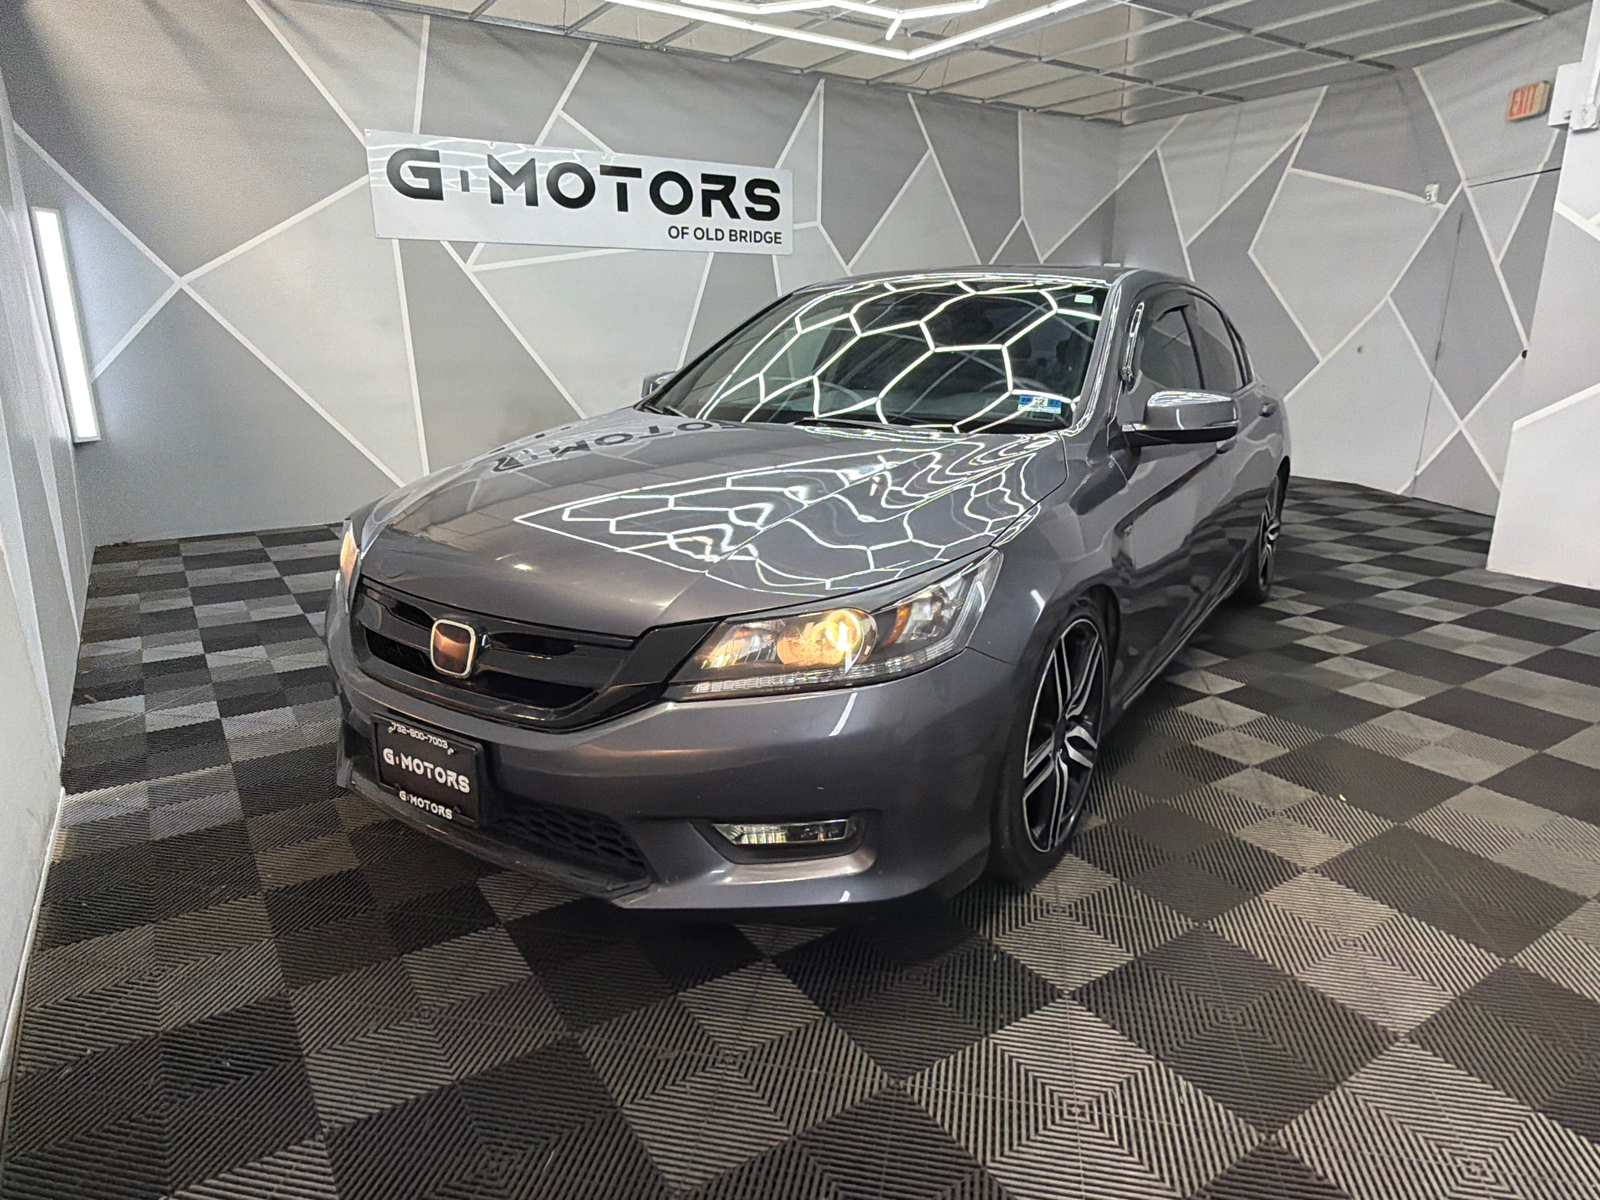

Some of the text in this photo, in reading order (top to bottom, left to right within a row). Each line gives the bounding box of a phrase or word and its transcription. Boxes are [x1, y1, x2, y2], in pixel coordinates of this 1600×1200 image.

[1508, 83, 1540, 119] EXIT
[668, 225, 782, 245] OF OLD BRIDGE
[391, 721, 448, 749] 732-800-7003
